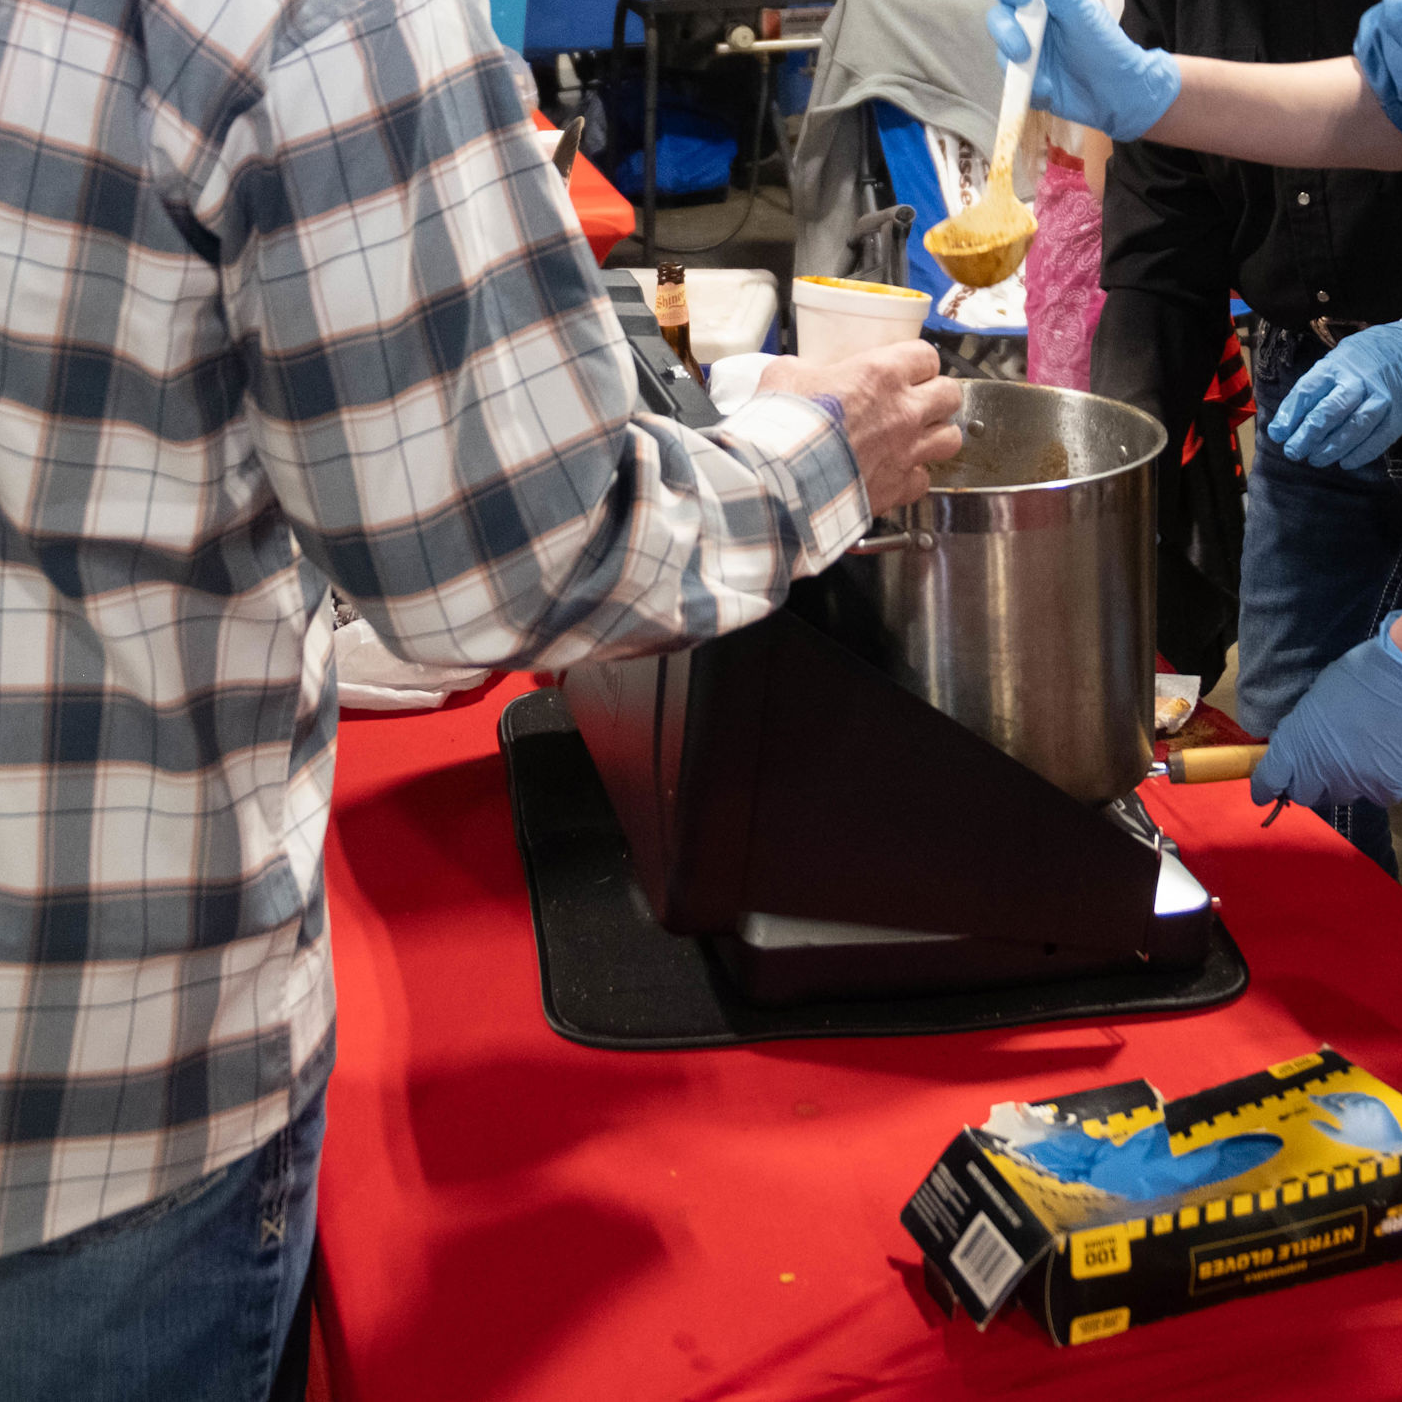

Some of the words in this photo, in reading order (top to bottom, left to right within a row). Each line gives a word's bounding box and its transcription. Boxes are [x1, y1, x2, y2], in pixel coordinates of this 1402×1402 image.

[1084, 1248, 1117, 1268] 100
[1276, 1224, 1357, 1263] NITRILE
[1197, 1246, 1276, 1281] GLOVES
